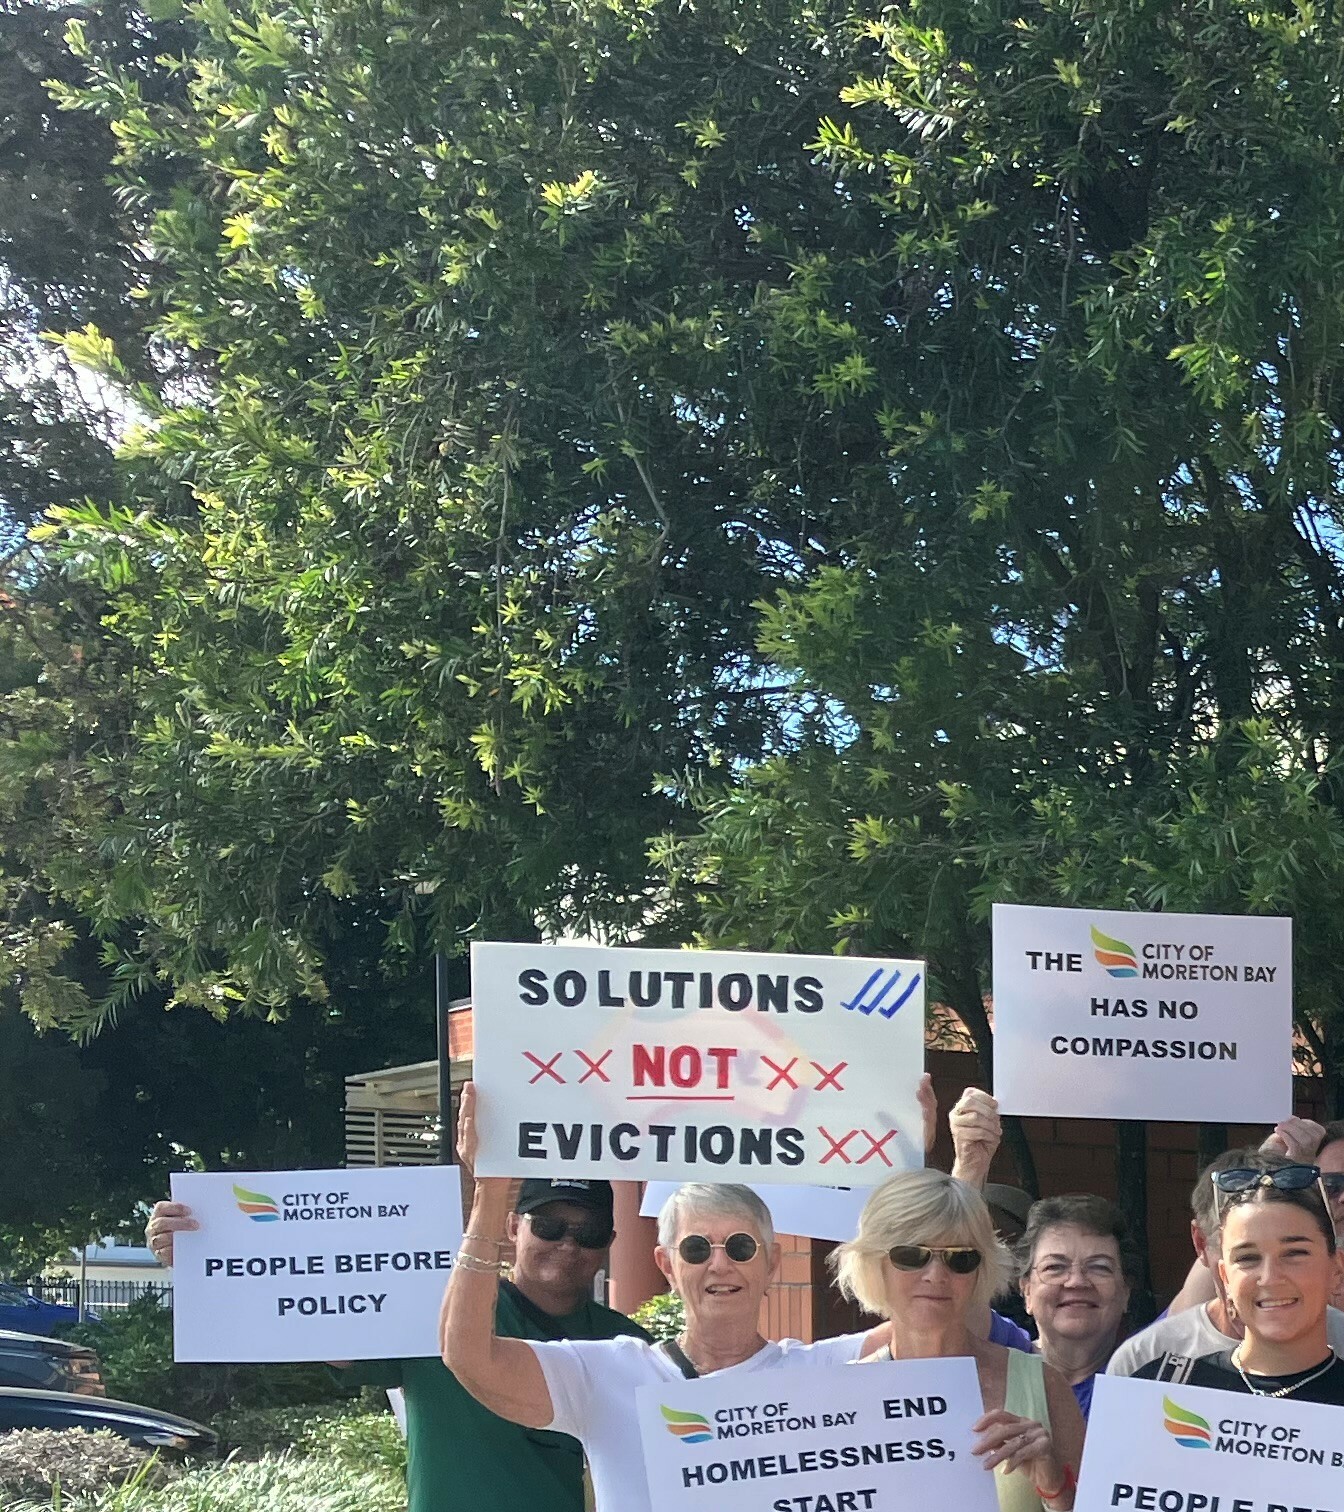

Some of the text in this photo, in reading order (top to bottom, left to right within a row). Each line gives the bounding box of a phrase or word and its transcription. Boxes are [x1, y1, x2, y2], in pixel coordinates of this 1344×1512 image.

[1025, 950, 1083, 973] THE
[1142, 943, 1215, 962] CITY OF
[1142, 962, 1277, 983] MORETON BAY
[518, 968, 824, 1014] SOLUTIONS
[1090, 997, 1198, 1020] HAS NO
[1050, 1035, 1237, 1060] COMPASSION
[631, 1044, 738, 1090] NOT
[517, 1121, 805, 1166] EVICTIONS
[282, 1191, 350, 1207] CITY OF
[283, 1204, 410, 1222] MORETON BAY
[205, 1250, 452, 1277] PEOPLE BEFORE
[278, 1293, 387, 1316] POLICY
[714, 1402, 789, 1423] CITY OF
[882, 1396, 947, 1420] END
[717, 1411, 857, 1440] MORETON BAY
[1218, 1419, 1301, 1443] CITY OF
[682, 1438, 956, 1488] HOMELESSNESS,
[1215, 1436, 1325, 1466] MORETON
